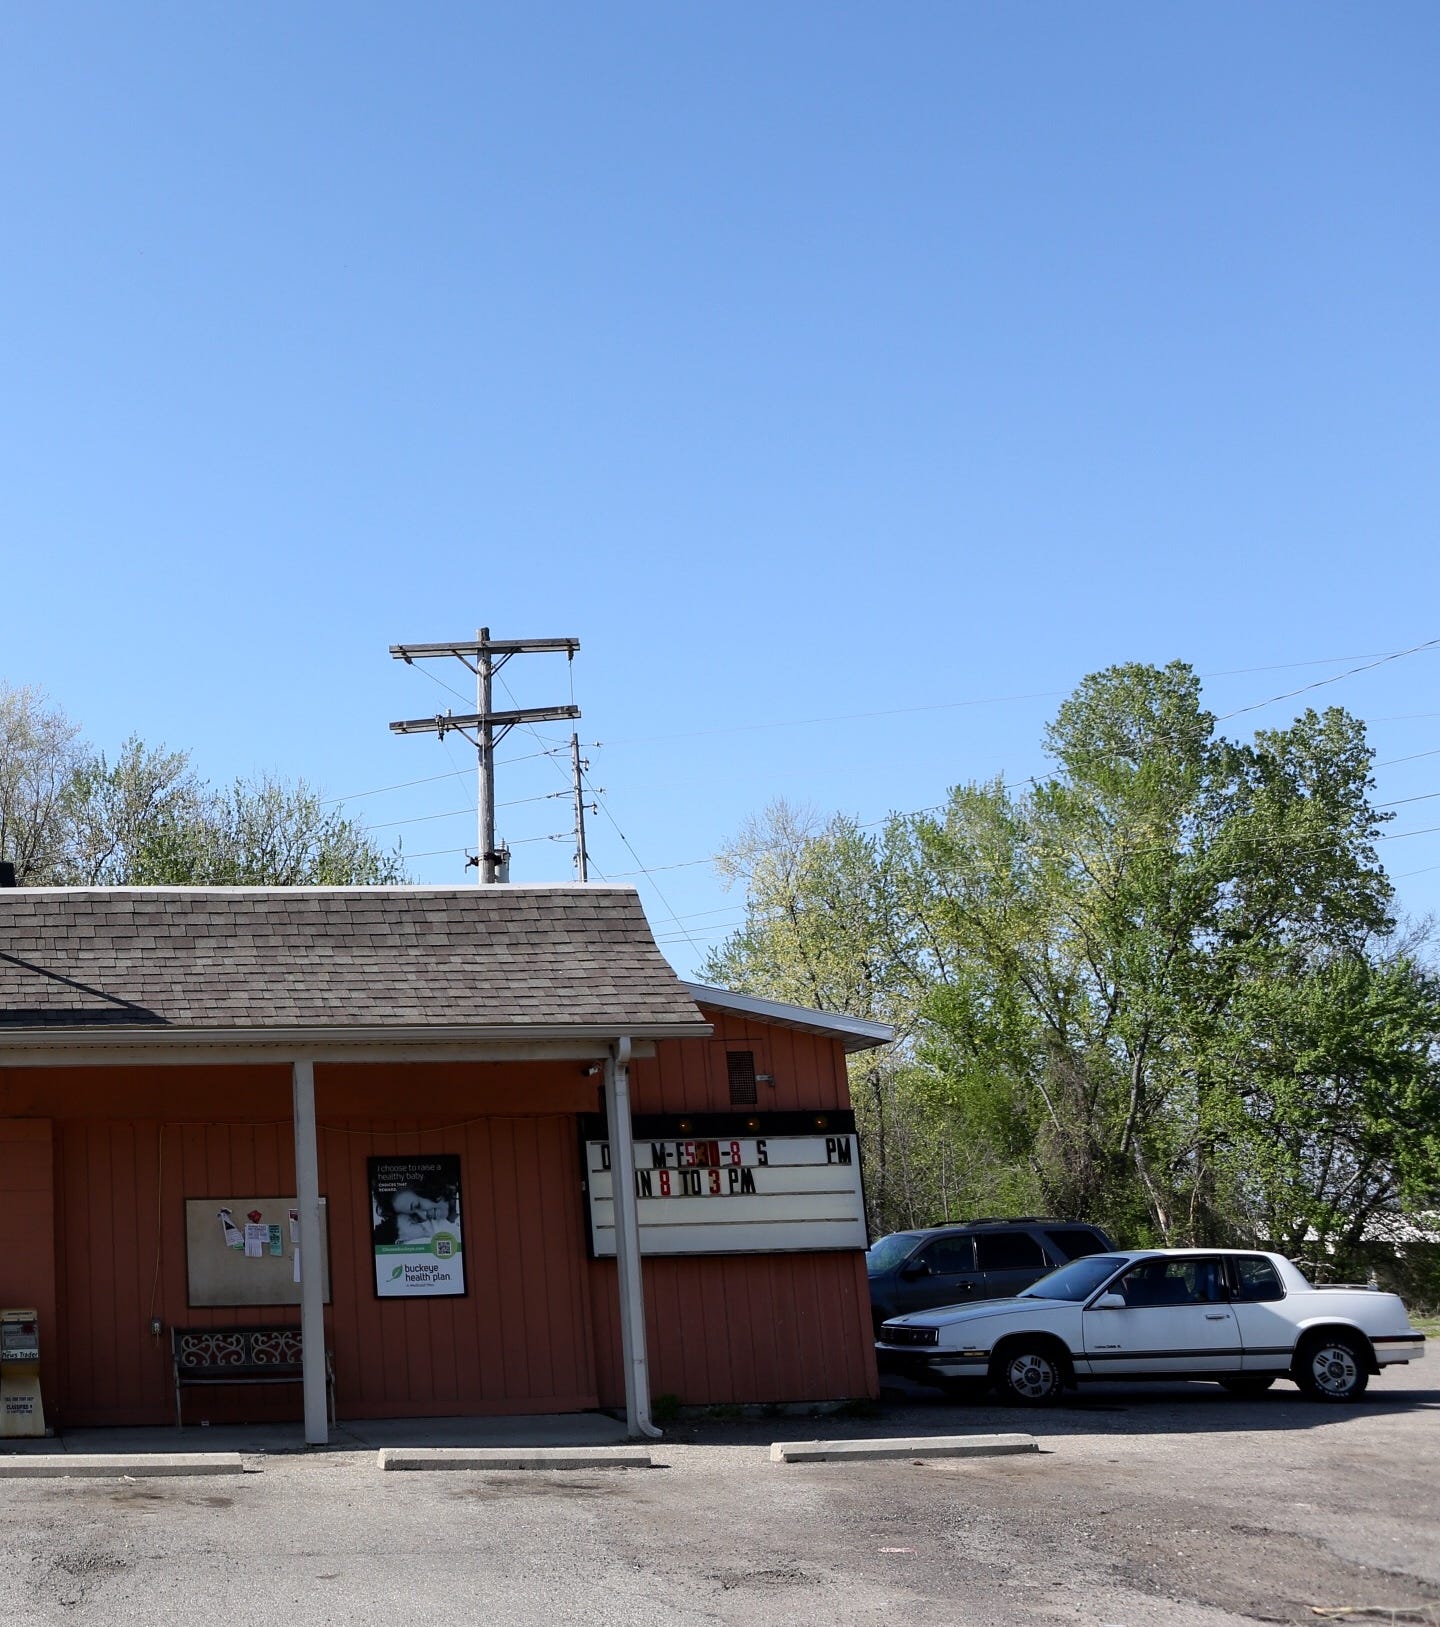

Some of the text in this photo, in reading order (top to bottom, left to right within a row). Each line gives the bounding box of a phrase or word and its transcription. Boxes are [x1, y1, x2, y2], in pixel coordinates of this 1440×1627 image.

[826, 1137, 852, 1164] PM
[380, 1164, 407, 1172] choose
[377, 1172, 424, 1181] healthy baby
[659, 1170, 671, 1196] 8
[679, 1170, 702, 1197] TO
[708, 1169, 721, 1195] 3
[728, 1168, 756, 1195] PM
[404, 1264, 439, 1273] buckeye
[405, 1273, 430, 1282] health
